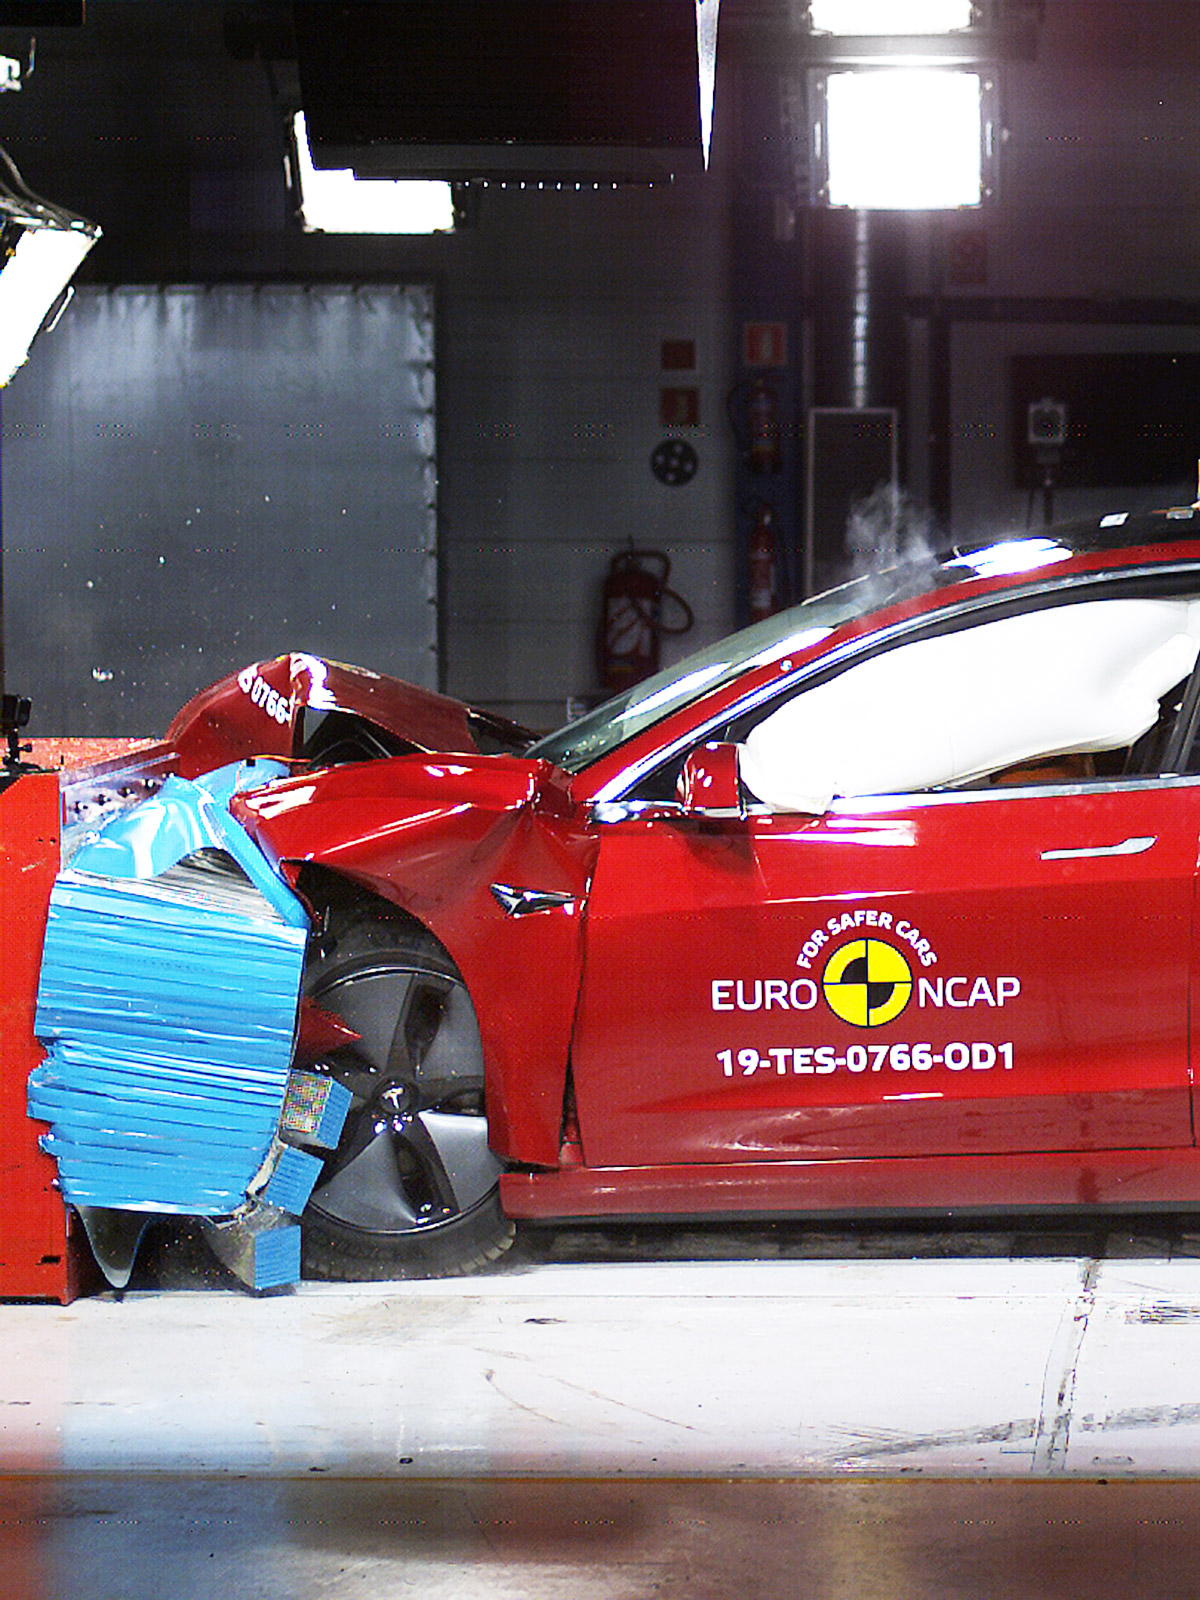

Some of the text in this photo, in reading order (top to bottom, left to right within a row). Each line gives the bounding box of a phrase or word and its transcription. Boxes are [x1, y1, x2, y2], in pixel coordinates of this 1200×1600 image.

[796, 910, 938, 969] FOR SAFER CARS
[710, 976, 1021, 1011] EURO NCAP
[715, 1042, 1014, 1077] 19-TES-0766-OD1
